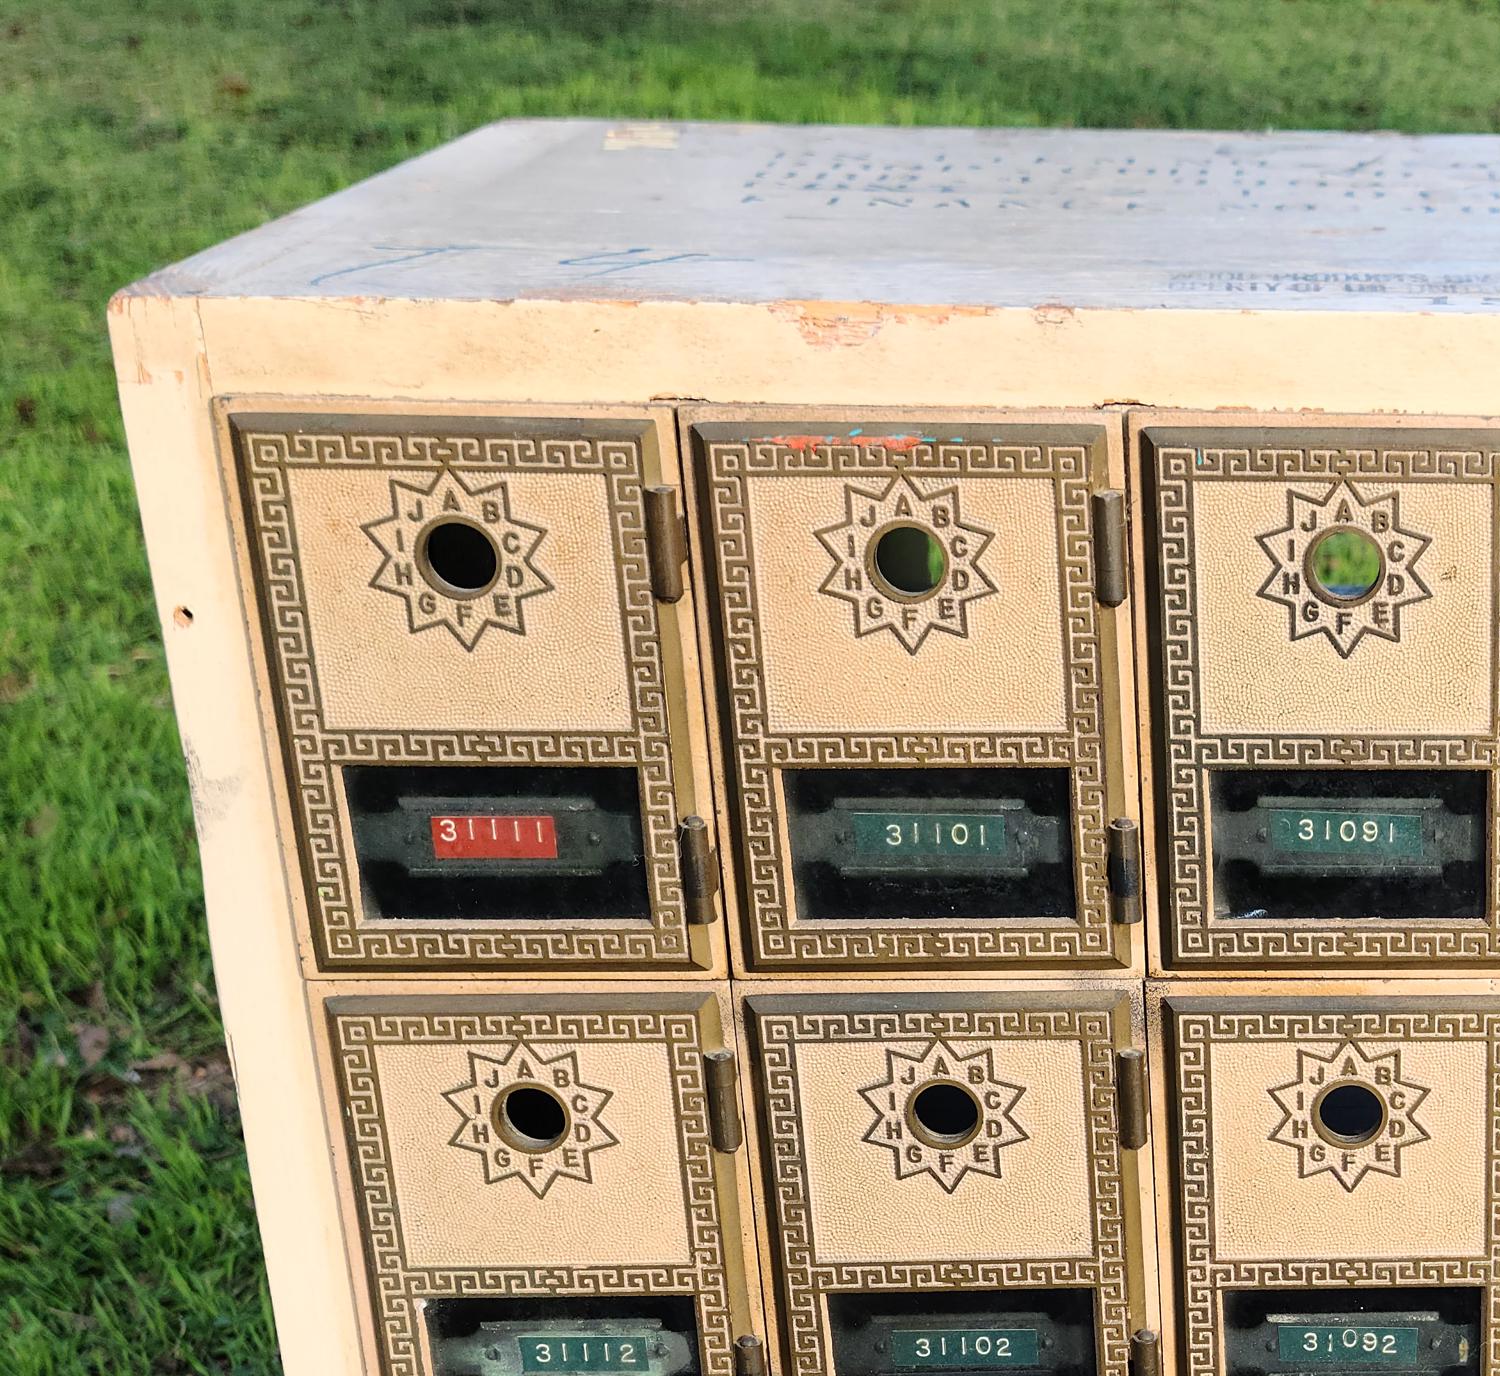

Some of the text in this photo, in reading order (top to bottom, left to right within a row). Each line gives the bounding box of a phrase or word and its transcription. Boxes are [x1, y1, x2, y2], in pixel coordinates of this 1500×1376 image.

[408, 500, 422, 521] J
[442, 489, 462, 511] A
[895, 494, 913, 517] A
[1336, 499, 1354, 521] A
[482, 501, 501, 521] B
[861, 507, 875, 527] J
[932, 505, 949, 527] B
[1301, 510, 1317, 531] J
[1372, 509, 1389, 530] B
[503, 533, 521, 554] C
[951, 538, 968, 559] C
[1388, 541, 1405, 562] C
[395, 563, 413, 584] H
[506, 565, 523, 587] D
[844, 569, 861, 590] H
[952, 570, 969, 591] D
[1282, 573, 1299, 595] H
[1388, 573, 1405, 595] D
[419, 593, 436, 614] G
[455, 603, 472, 625] F
[494, 595, 512, 616] E
[866, 598, 883, 618] G
[939, 598, 955, 620] E
[1303, 601, 1320, 622] G
[1372, 602, 1388, 624] E
[901, 609, 918, 631] F
[1337, 612, 1352, 634] F
[439, 819, 543, 842] 31111
[886, 823, 984, 845] 31101
[1298, 820, 1393, 842] 31091
[517, 1059, 534, 1079] A
[1310, 1067, 1324, 1085] J
[1341, 1057, 1358, 1076] A
[1375, 1067, 1391, 1084] B
[485, 1070, 499, 1088] J
[554, 1069, 570, 1086] B
[573, 1095, 588, 1113] C
[1390, 1091, 1405, 1109] C
[473, 1124, 489, 1143] H
[574, 1124, 590, 1143] D
[1293, 1121, 1308, 1139] H
[1389, 1118, 1405, 1137] D
[495, 1149, 510, 1167] G
[563, 1149, 579, 1167] E
[1310, 1143, 1325, 1161] G
[1342, 1152, 1356, 1171] F
[1375, 1144, 1390, 1162] E
[528, 1158, 544, 1177] F
[916, 1336, 1011, 1357] 31102
[1303, 1330, 1397, 1353] 31092
[536, 1343, 636, 1363] 31112
